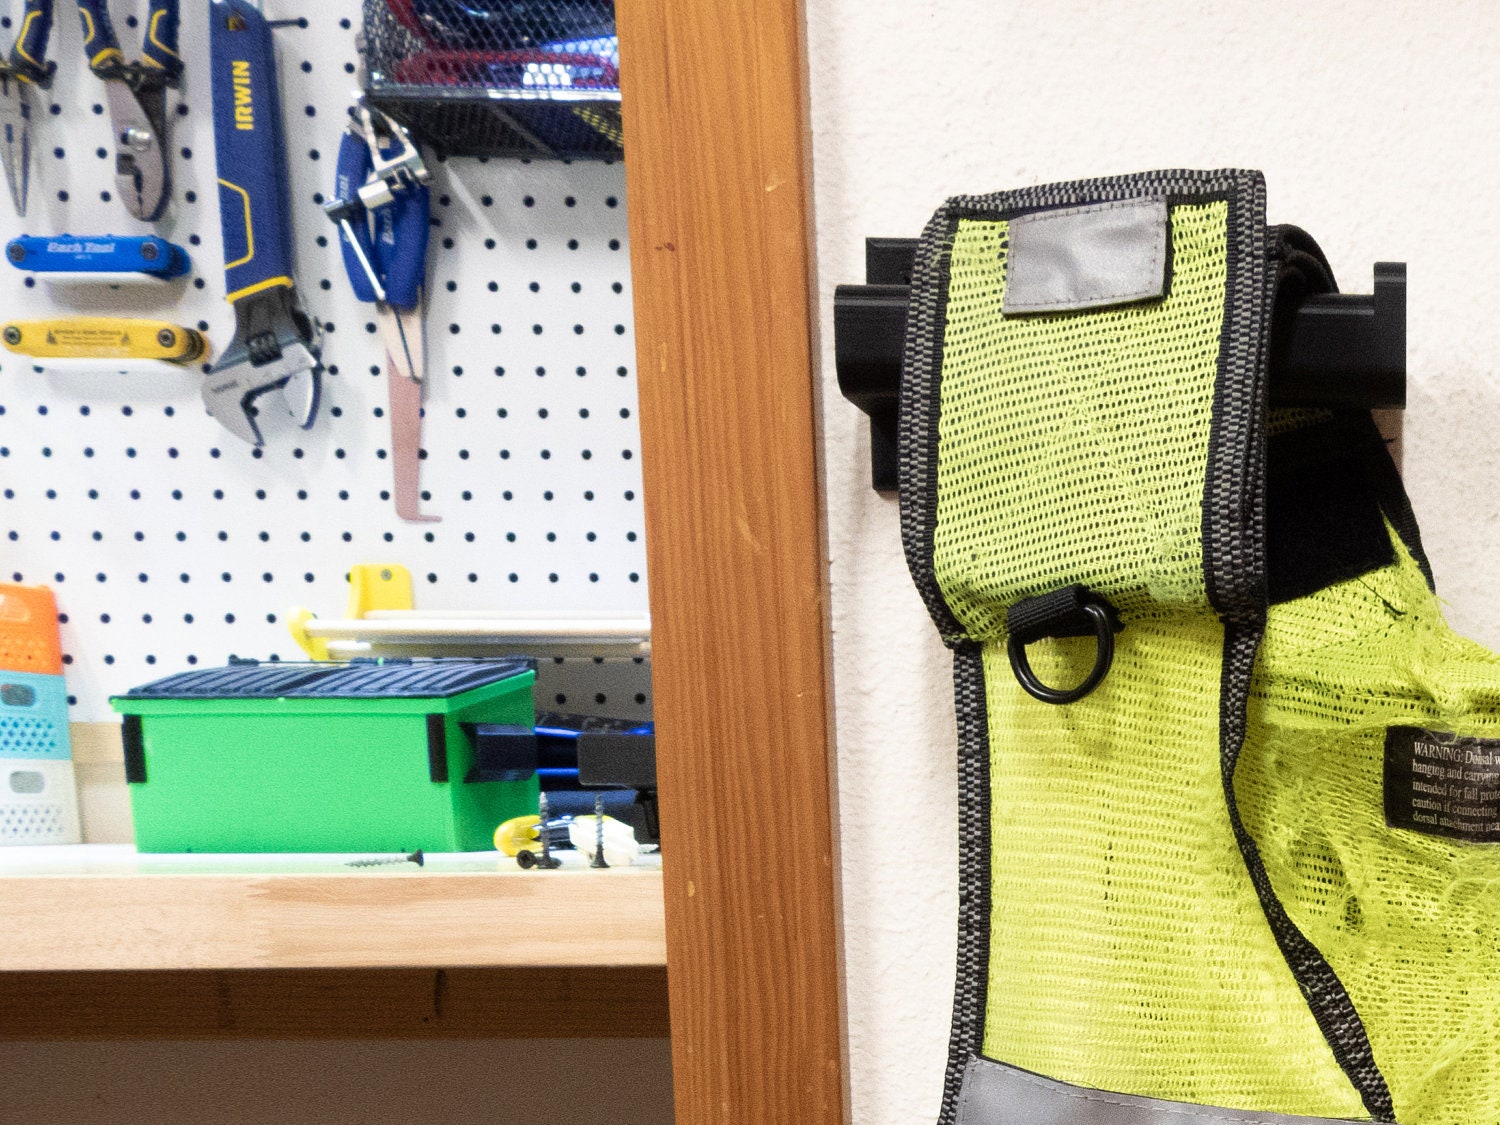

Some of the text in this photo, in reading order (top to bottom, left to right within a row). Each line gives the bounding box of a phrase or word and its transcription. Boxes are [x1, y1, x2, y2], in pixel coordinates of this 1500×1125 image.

[232, 61, 254, 130] IRWIN
[1414, 742, 1464, 763] WARNING:
[1465, 750, 1493, 765] Dorsal
[1412, 759, 1445, 780] hanging
[1447, 767, 1462, 779] and
[1412, 779, 1447, 796] intended
[1450, 785, 1462, 799] for
[1464, 787, 1478, 800] fall
[1412, 798, 1442, 812] caution
[1444, 801, 1451, 813] if
[1452, 805, 1498, 817] connecting
[1413, 811, 1437, 825] dorsal
